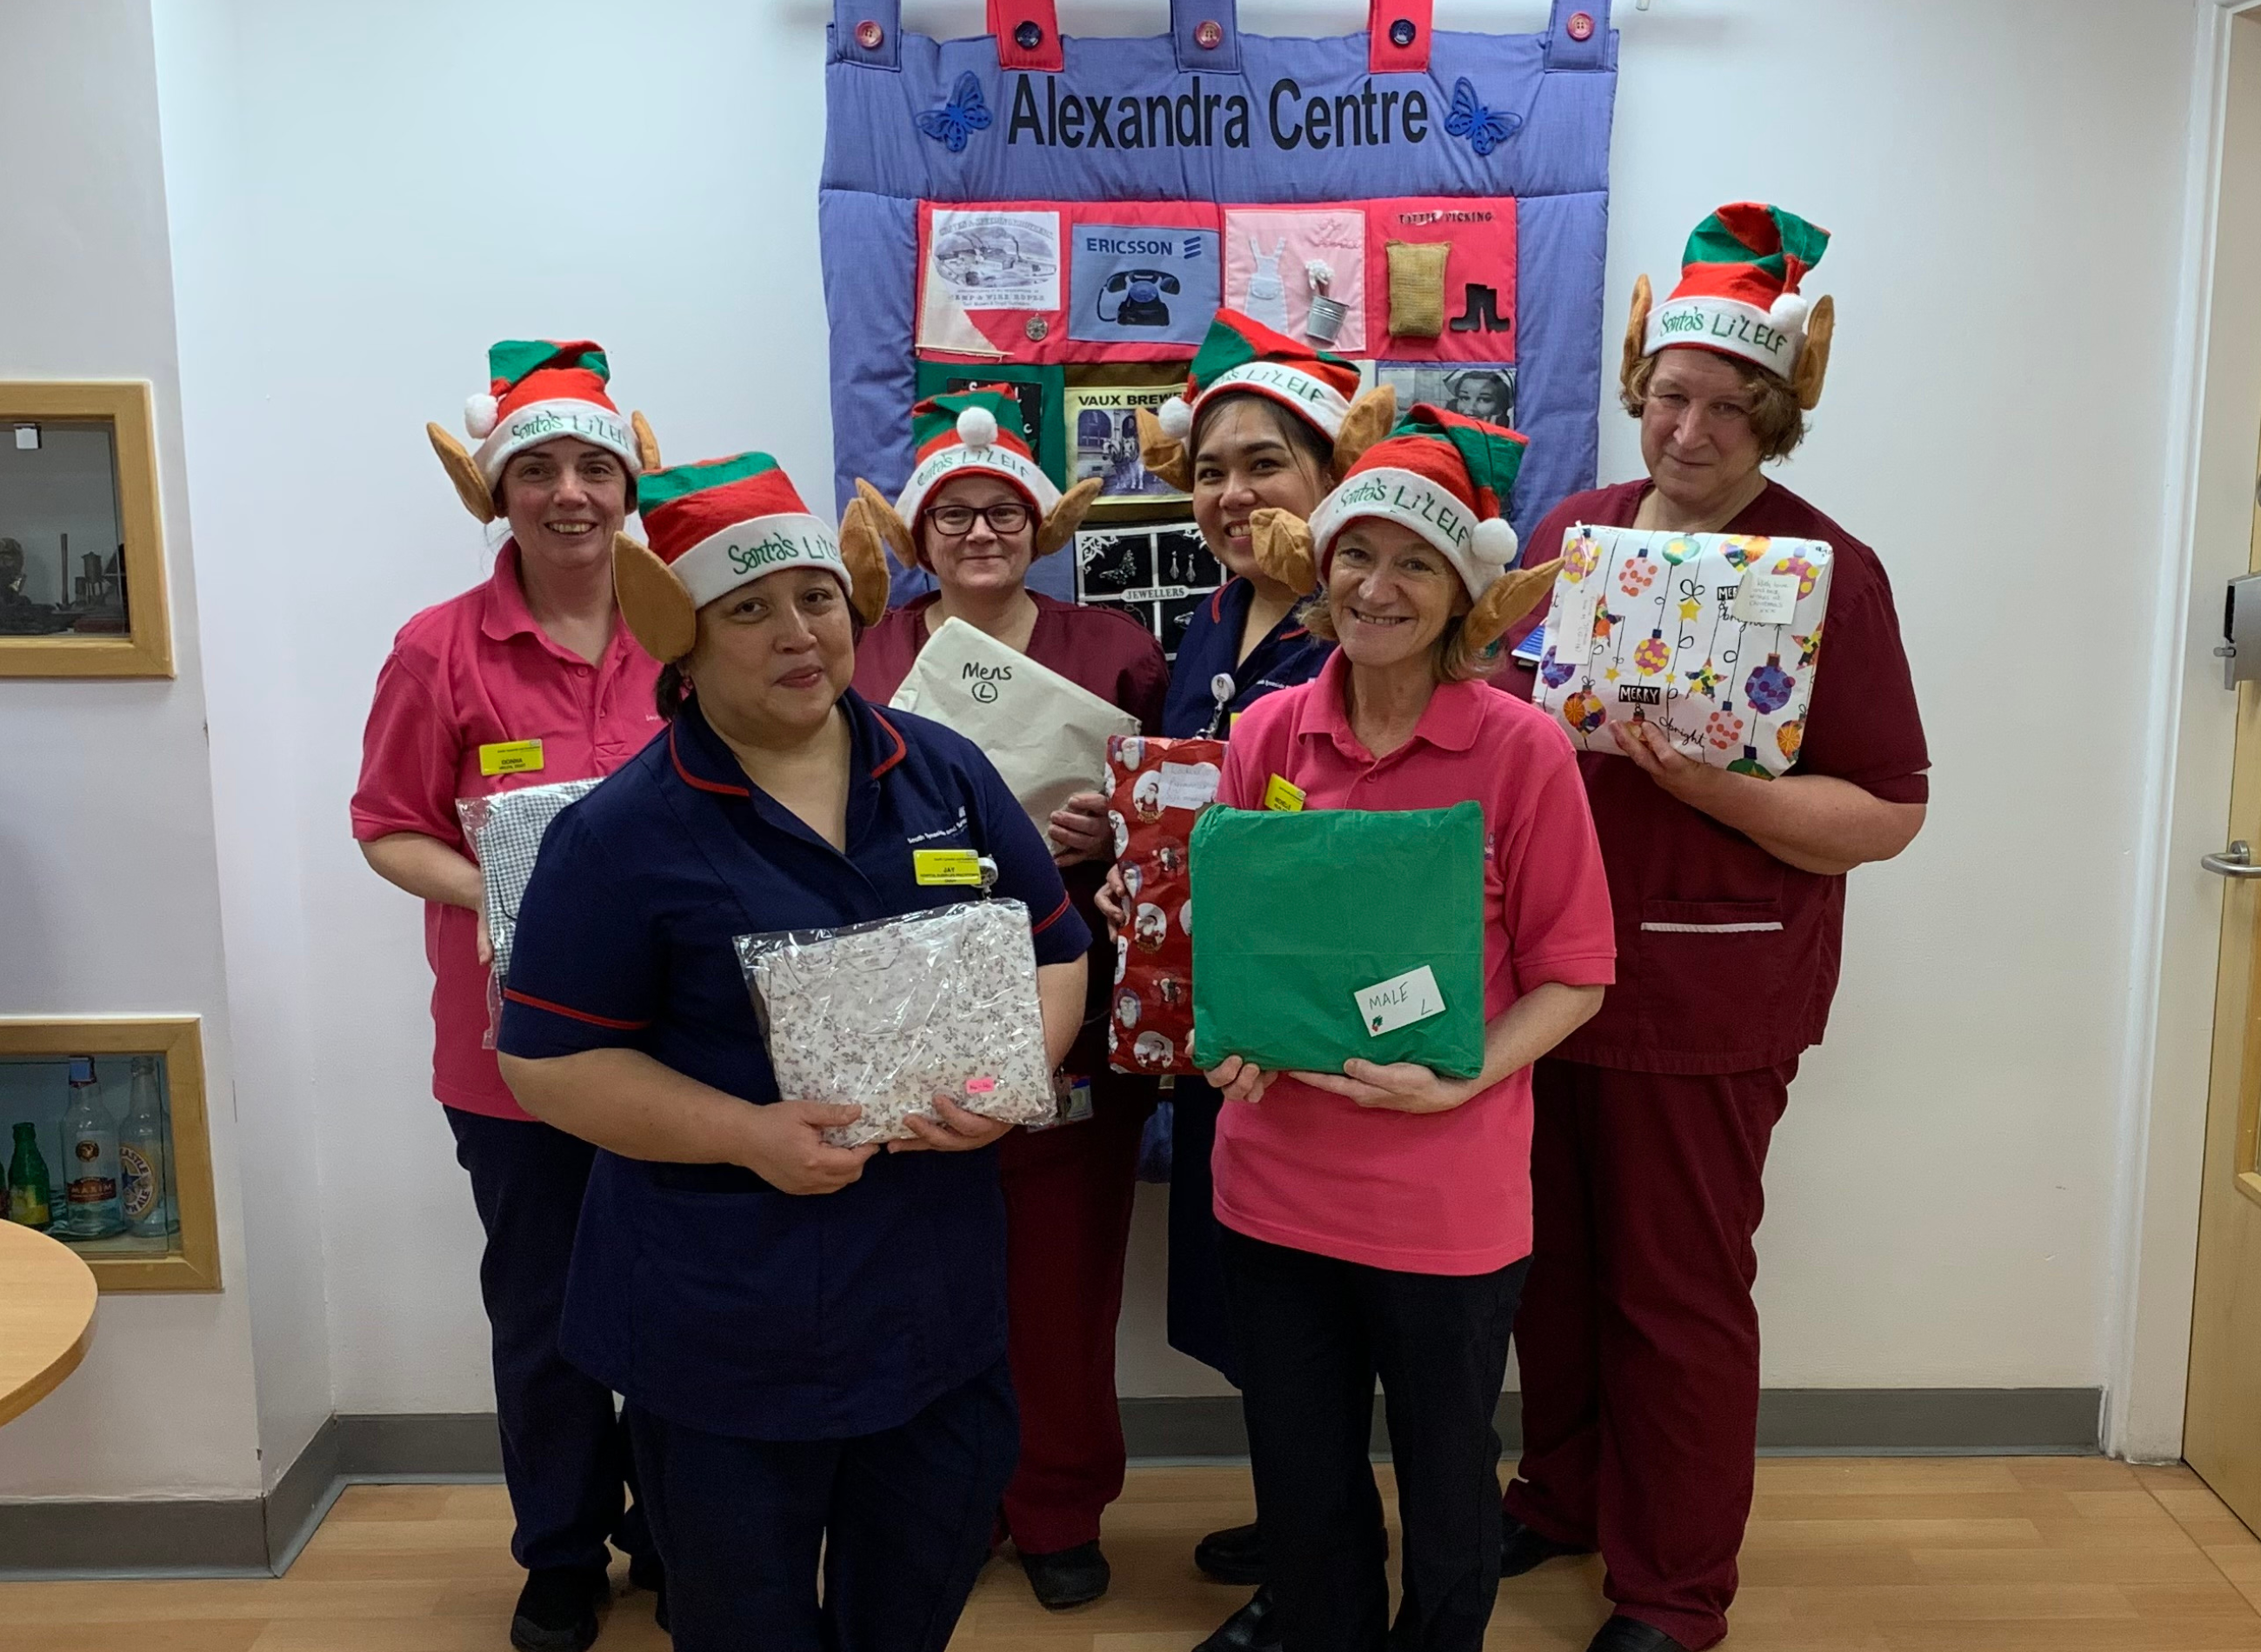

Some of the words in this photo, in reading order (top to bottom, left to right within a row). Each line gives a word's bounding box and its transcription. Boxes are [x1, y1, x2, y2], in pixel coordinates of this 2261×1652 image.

[1008, 73, 1250, 150] Alexandra
[1269, 77, 1429, 150] Centre
[1444, 211, 1492, 223] PICKING
[1086, 237, 1172, 255] ERICSSON
[1660, 306, 1704, 337] Santa's
[1753, 323, 1788, 355] ELF
[1078, 395, 1121, 406] VAUX
[511, 410, 564, 445] Santa's
[1437, 507, 1470, 548] ELF
[728, 531, 799, 575] Santa's
[1126, 588, 1185, 601] JEWELLERS
[962, 662, 1012, 681] Mens
[1620, 686, 1659, 703] MERRY
[1659, 716, 1706, 749] bright
[1369, 981, 1409, 1010] MALE
[1420, 998, 1434, 1016] L
